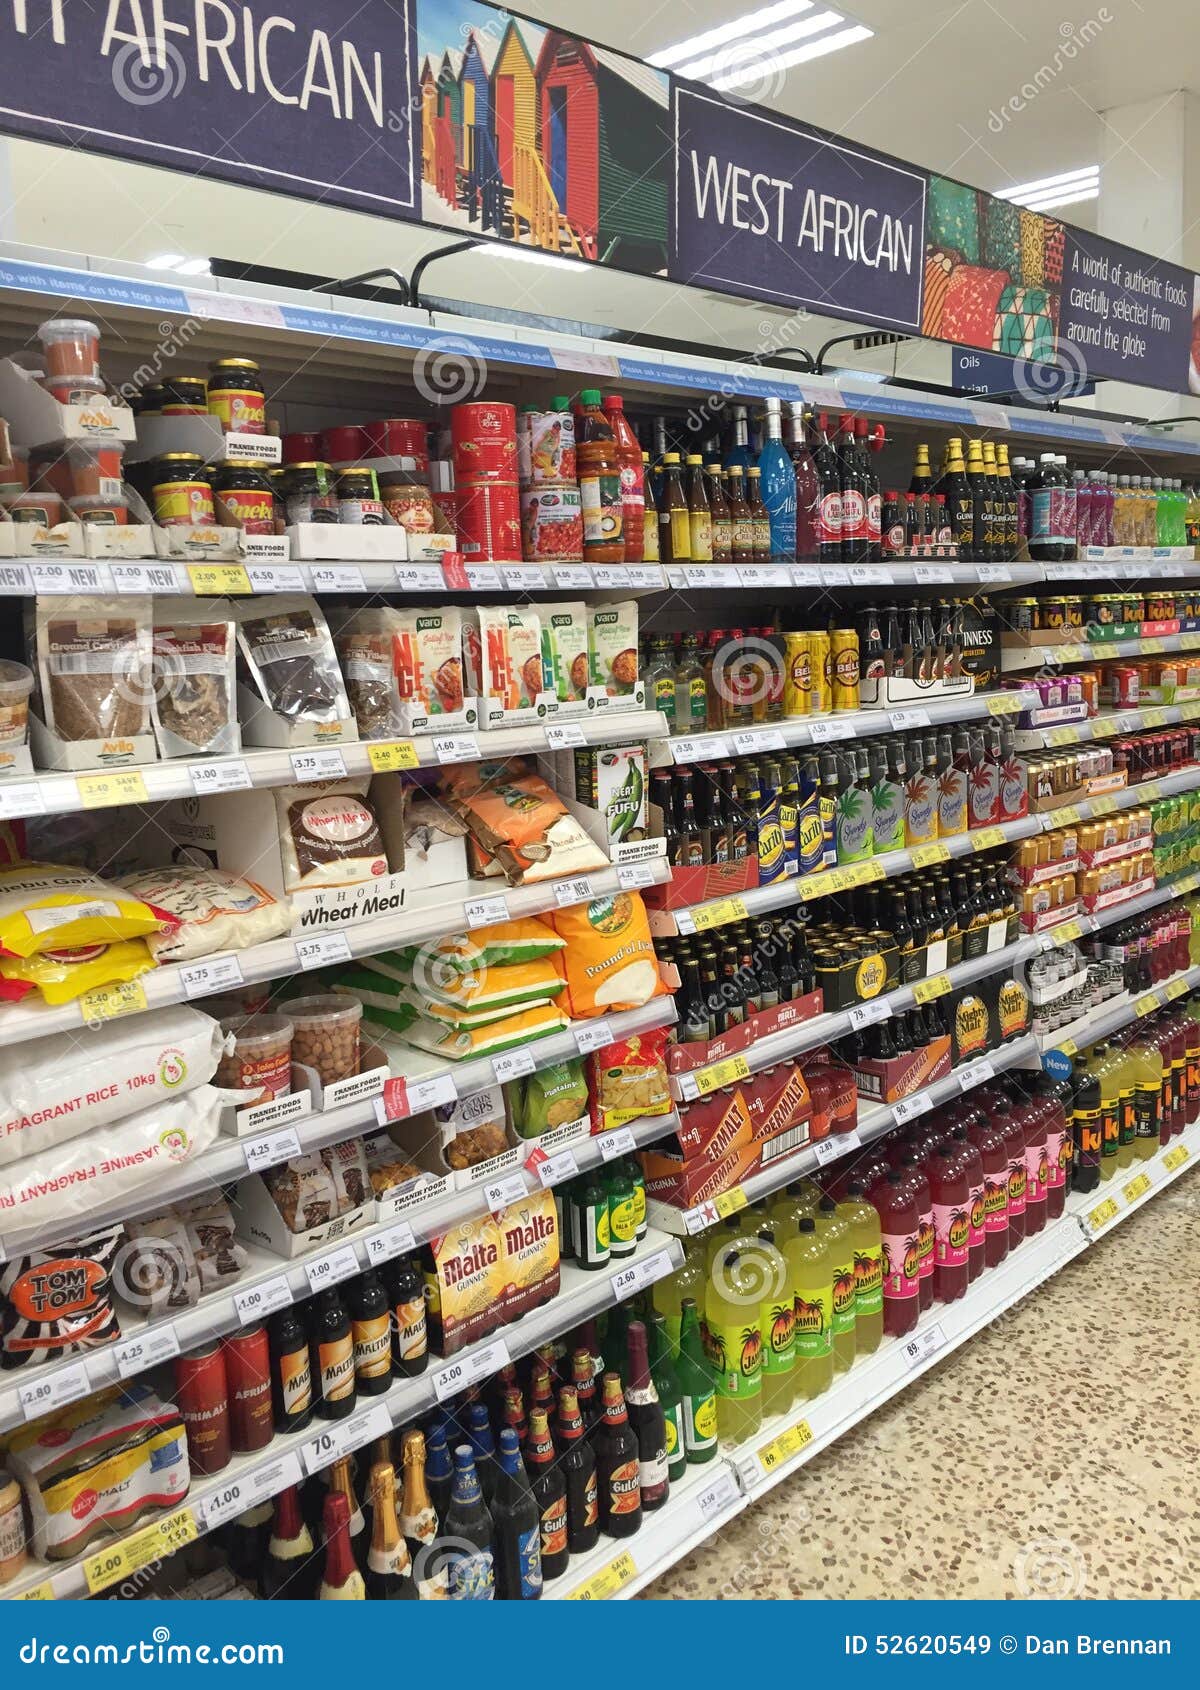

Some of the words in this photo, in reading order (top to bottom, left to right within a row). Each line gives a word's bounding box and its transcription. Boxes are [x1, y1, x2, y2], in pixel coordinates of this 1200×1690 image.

[101, 0, 384, 127] AFRICAN
[691, 150, 794, 242] WEST
[797, 188, 914, 275] AFRICAN
[18, 274, 47, 288] with
[51, 276, 86, 293] items
[1071, 250, 1082, 273] A
[1083, 257, 1109, 281] world
[1111, 264, 1123, 286] of
[1125, 269, 1163, 299] authentic
[1165, 281, 1187, 308] foods
[1070, 287, 1109, 320] carefully
[1112, 300, 1148, 326] selected
[1151, 307, 1171, 332] from
[1067, 321, 1101, 346] around
[1104, 326, 1119, 351] the
[1121, 331, 1146, 359] globe
[959, 356, 981, 369] Oils
[256, 445, 278, 453] FOODS
[69, 568, 98, 588] NEW
[146, 569, 174, 588] NEW
[222, 569, 242, 579] SAVE
[419, 617, 441, 627] varo
[553, 615, 572, 625] varo
[596, 612, 617, 623] varo
[50, 641, 88, 651] Ground
[607, 800, 640, 817] FUFU
[642, 844, 659, 853] FOODS
[53, 875, 95, 889] Gari
[573, 879, 590, 896] NEW
[301, 903, 359, 927] Wheat
[361, 888, 406, 915] Meal
[1000, 990, 1026, 1005] Mighty
[958, 1006, 986, 1023] Mighty
[1003, 1001, 1022, 1016] Malt
[960, 1016, 982, 1034] Malt
[895, 1047, 930, 1097] SUPERMALT
[1045, 1057, 1070, 1071] New
[125, 1072, 156, 1091] 10kg
[334, 1084, 359, 1097] FRANIK
[360, 1075, 381, 1088] FOODS
[7, 1099, 81, 1136] FRAGRANT
[86, 1083, 120, 1106] RICE
[249, 1105, 278, 1120] FRANIK
[278, 1098, 302, 1111] FOODS
[281, 1105, 302, 1116] AFRICA
[462, 1100, 494, 1121] CRISPS
[539, 1131, 564, 1144] FRANIK
[564, 1121, 583, 1133] FOODS
[101, 1144, 160, 1174] JASMINE
[471, 1161, 496, 1174] FRANIK
[497, 1149, 518, 1162] FOODS
[19, 1160, 97, 1208] FRAGRANT
[394, 1190, 423, 1206] FRANIK
[423, 1178, 447, 1194] FOODS
[427, 1186, 447, 1200] AFRICA
[505, 1213, 555, 1252] Malta
[518, 1239, 548, 1261] GUINNESS
[444, 1241, 498, 1287] Malta
[31, 1267, 88, 1288] TOM
[456, 1269, 490, 1292] GUINNESS
[30, 1287, 87, 1313] TOM
[439, 1365, 463, 1386] £3.00
[458, 1477, 479, 1489] STAR
[210, 1484, 241, 1513] £1.00
[91, 1555, 122, 1579] £2.00
[611, 1554, 629, 1573] SAVE
